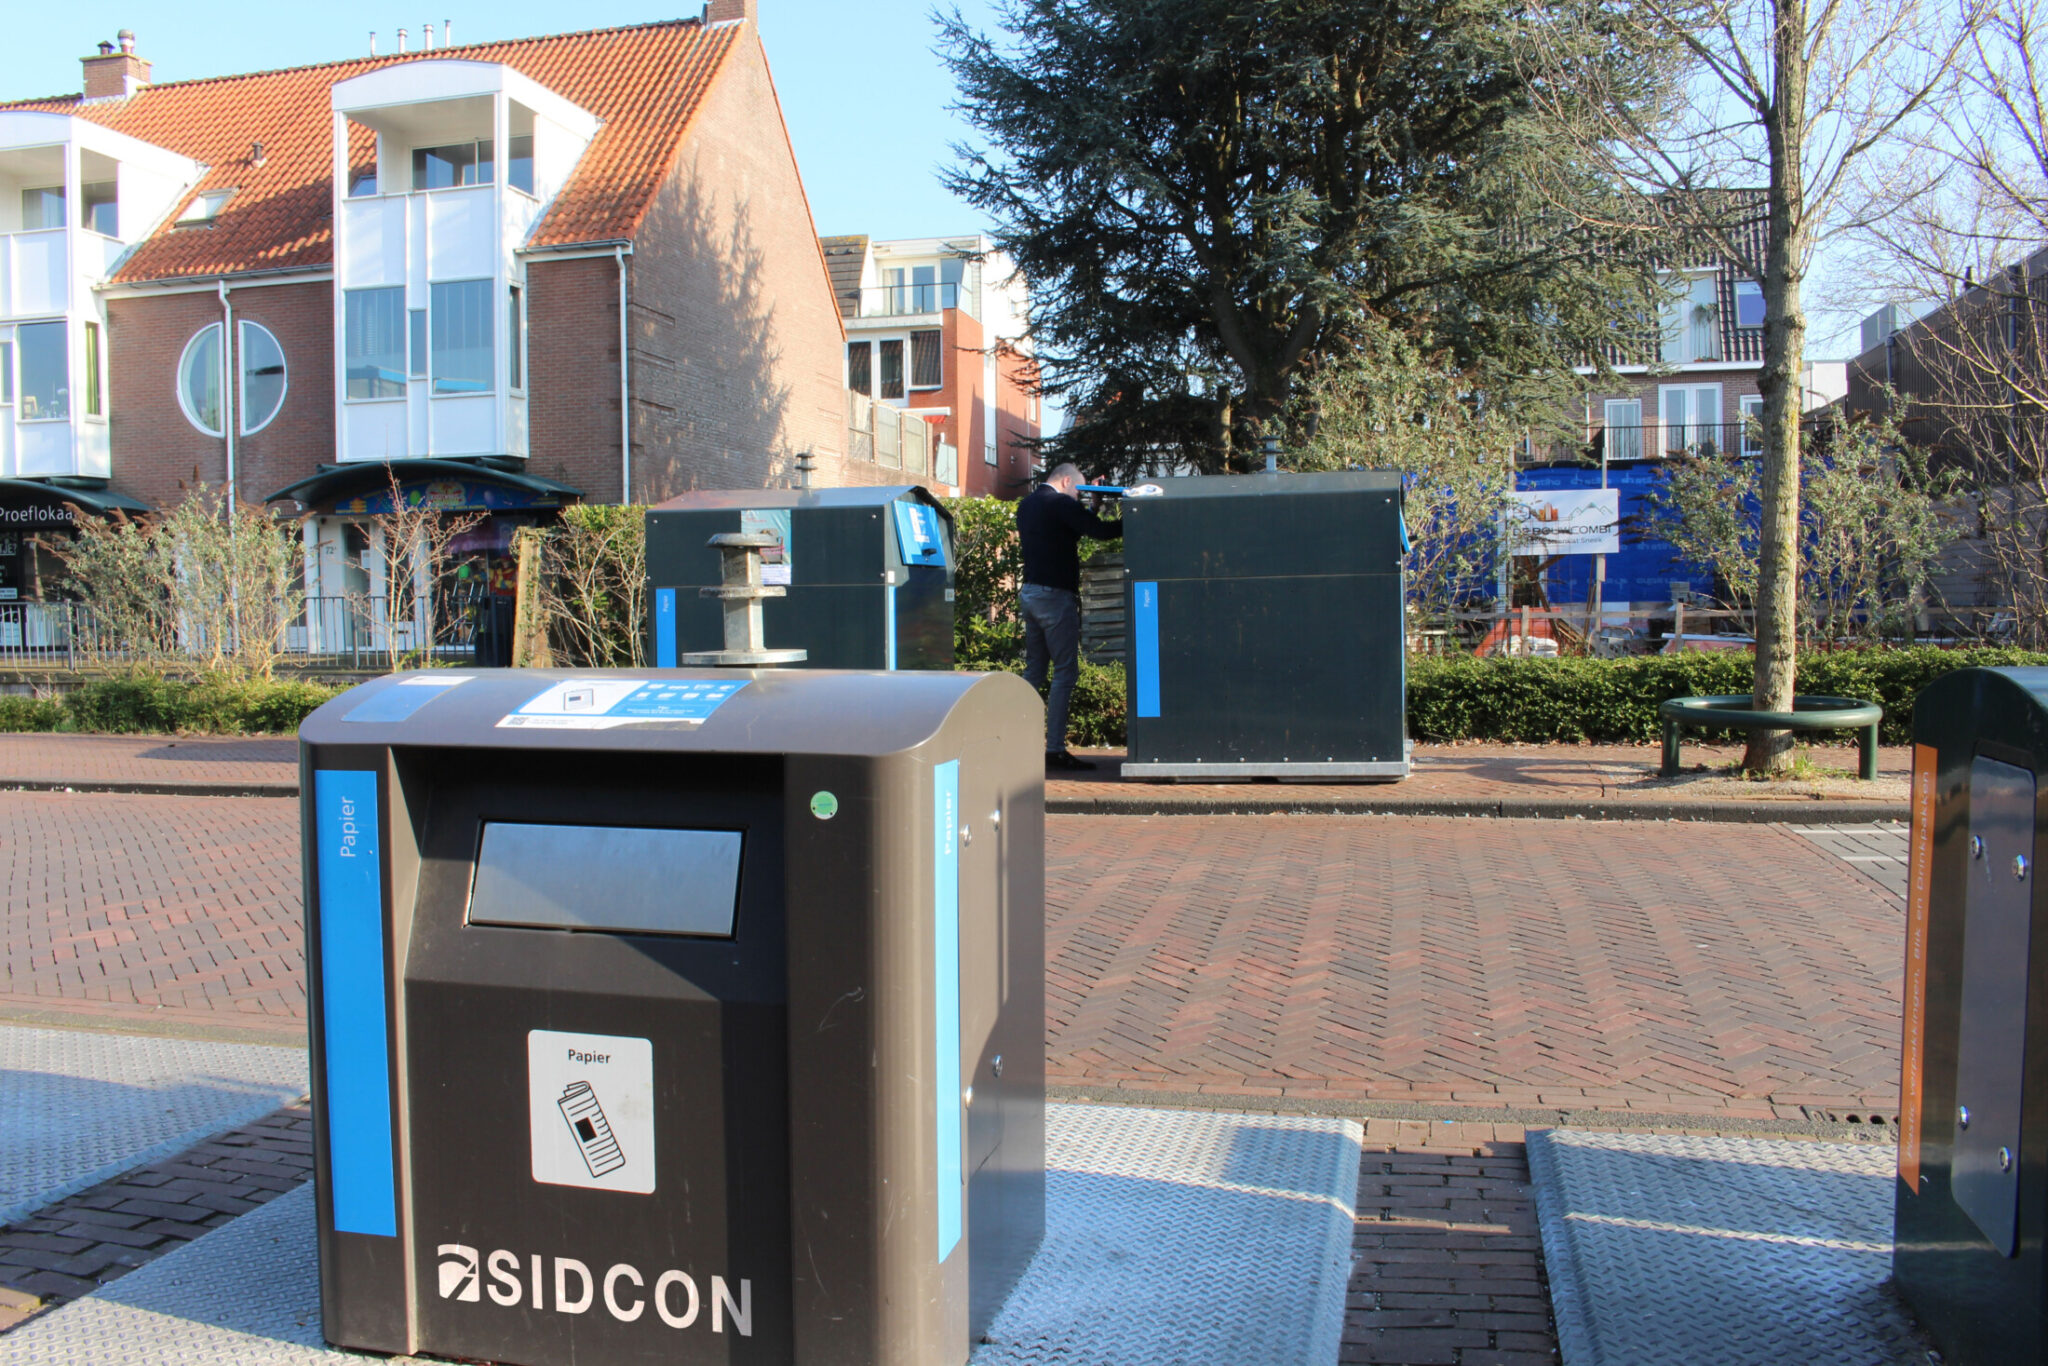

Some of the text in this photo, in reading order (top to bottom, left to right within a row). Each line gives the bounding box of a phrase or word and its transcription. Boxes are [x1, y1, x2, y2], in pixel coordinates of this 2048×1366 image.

[0, 505, 77, 521] Proeflokaa
[338, 796, 359, 857] Papier
[944, 789, 953, 856] Papier
[1916, 771, 1929, 891] Drinkpakken
[1916, 897, 1923, 921] en
[1914, 927, 1922, 960] Blik
[568, 1048, 611, 1065] Papier
[1907, 1104, 1916, 1159] Plastic
[487, 1249, 752, 1337] SIDCON
